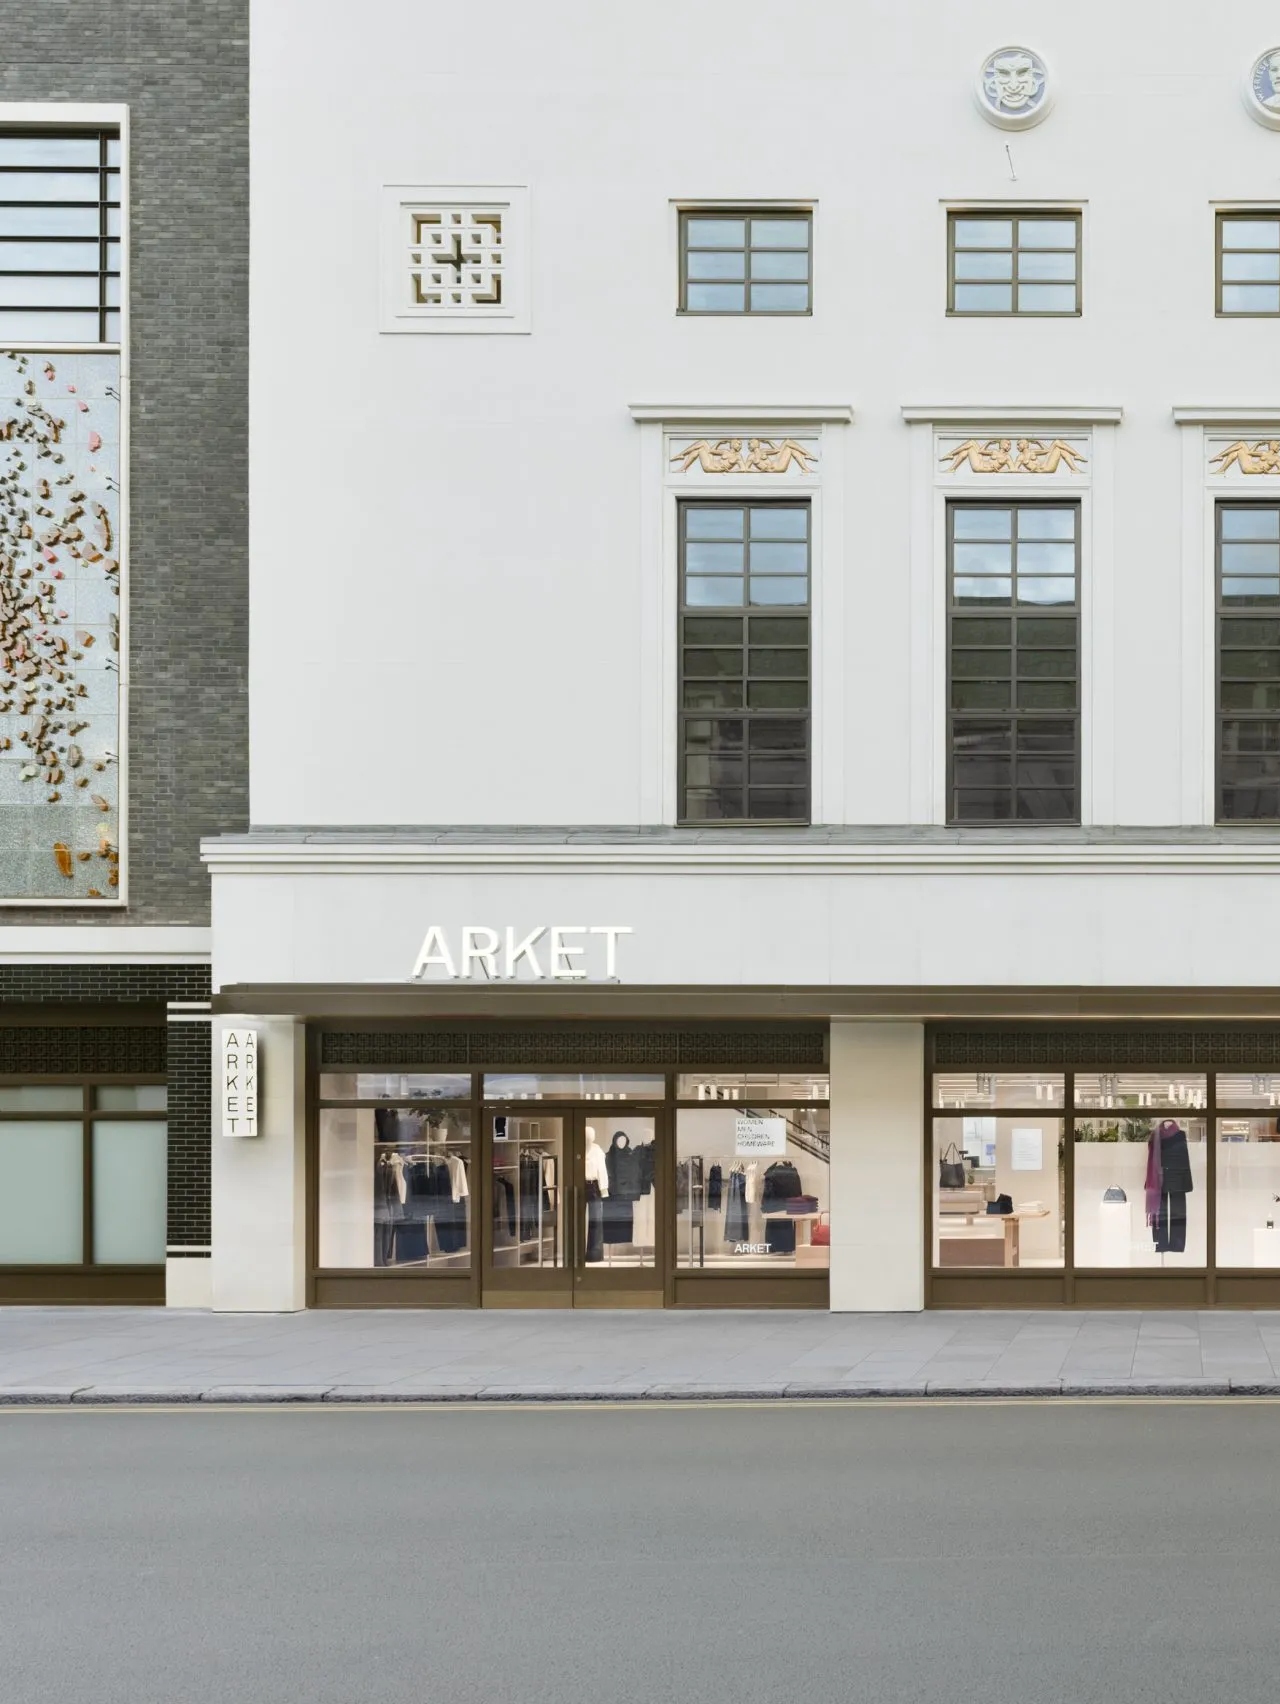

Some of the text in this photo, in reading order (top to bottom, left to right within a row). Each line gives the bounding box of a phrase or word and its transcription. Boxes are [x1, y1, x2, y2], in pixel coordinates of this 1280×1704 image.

[411, 925, 633, 978] ARKET
[226, 1032, 240, 1134] ARKET
[245, 1033, 255, 1134] ARKET
[734, 1243, 772, 1254] ARKET
